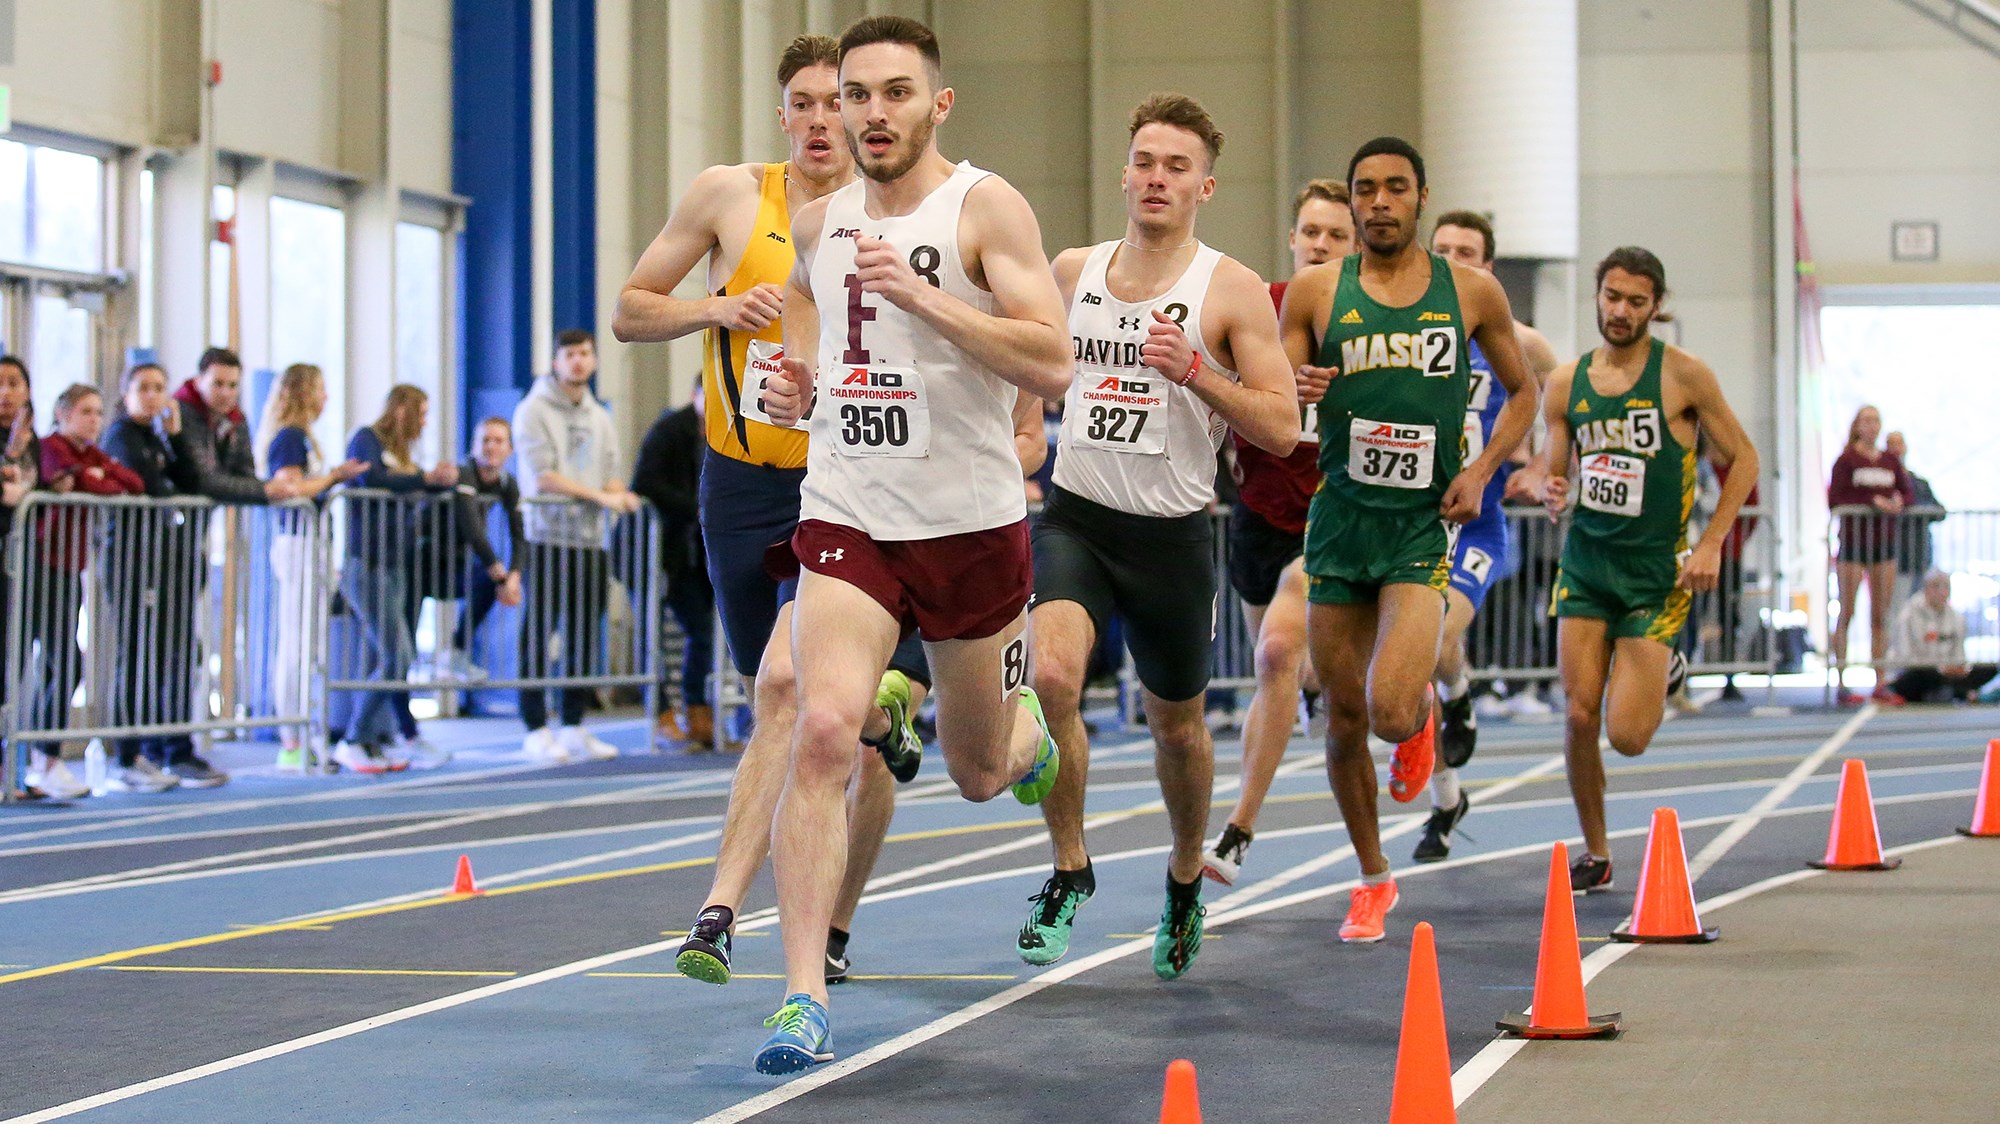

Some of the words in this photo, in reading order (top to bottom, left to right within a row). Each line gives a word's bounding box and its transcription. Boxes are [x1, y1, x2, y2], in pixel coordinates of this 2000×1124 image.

[767, 232, 785, 243] A10
[909, 245, 940, 289] 8
[1081, 292, 1102, 305] A10
[843, 273, 877, 364] F
[1417, 311, 1451, 321] A10
[1073, 336, 1149, 368] DAVIDS
[1341, 332, 1424, 376] MASO
[1426, 332, 1451, 373] 2
[842, 368, 902, 387] A10
[1096, 376, 1149, 394] A10
[830, 388, 917, 400] CHAMPIONSHIPS
[1083, 392, 1160, 406] CHAMPIONSHIPS
[841, 404, 909, 446] 350
[1088, 405, 1148, 443] 327
[1369, 424, 1420, 440] A10
[1634, 414, 1654, 448] 5
[1356, 436, 1428, 449] CHAMPIONSHIPS
[1363, 448, 1418, 481] 373
[1593, 455, 1630, 470] A10
[1589, 477, 1628, 507] 359
[1005, 640, 1022, 691] 8
